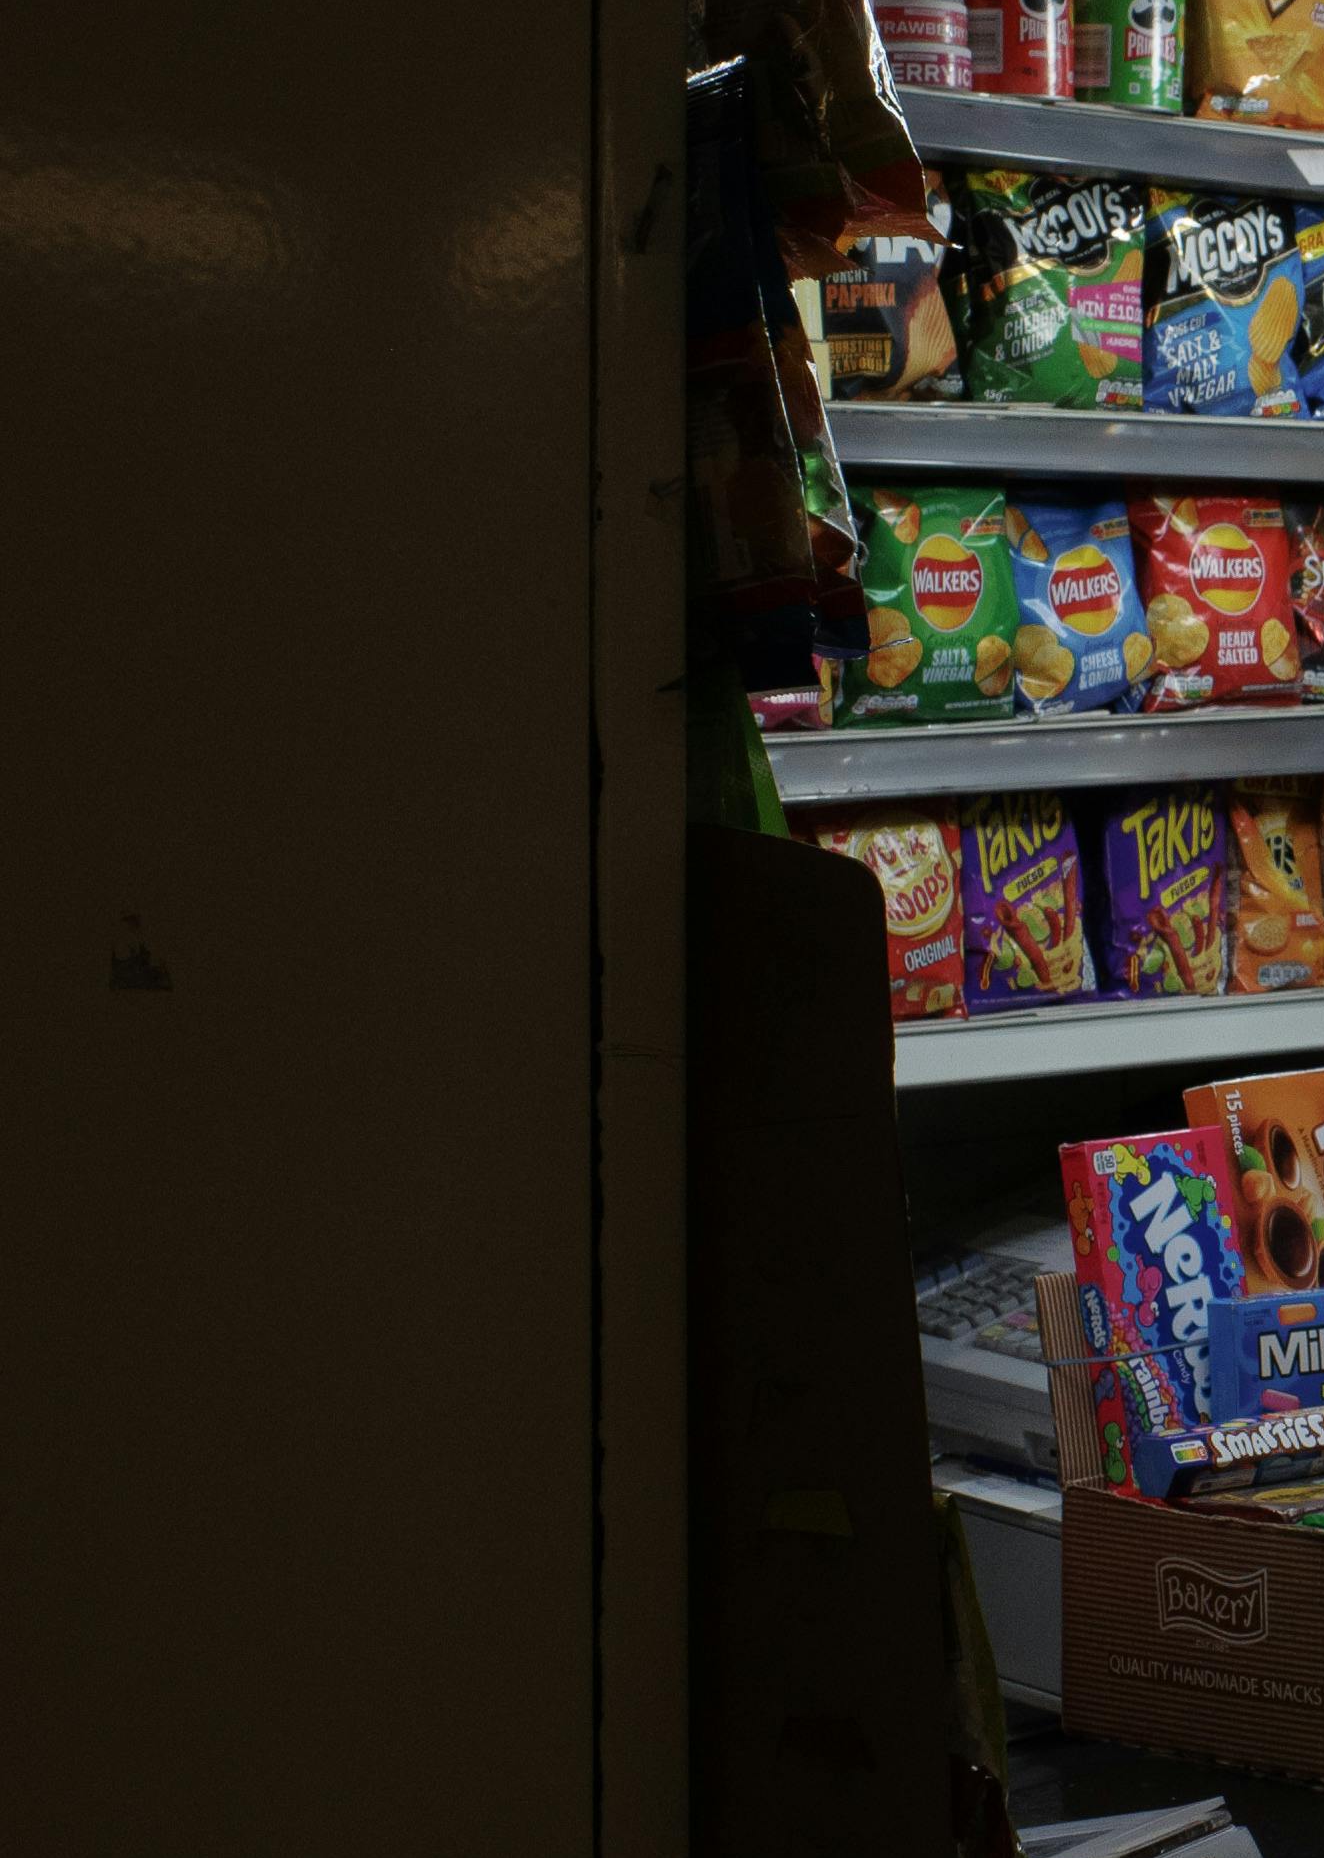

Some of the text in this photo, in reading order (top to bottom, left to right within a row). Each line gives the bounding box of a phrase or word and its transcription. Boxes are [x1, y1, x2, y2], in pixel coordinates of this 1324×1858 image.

[913, 567, 981, 595] WALKERS
[1191, 554, 1262, 582] WALKERS
[1049, 575, 1120, 605] WALKERS
[1219, 630, 1256, 650] READY
[1080, 649, 1122, 673] CHEESE
[1218, 648, 1258, 667] SALTED
[922, 664, 974, 684] VINEGAR
[966, 791, 1065, 890] Takis
[1122, 791, 1215, 899] Takis
[1014, 867, 1046, 893] FUEGO
[1169, 876, 1200, 900] FUEGO
[903, 937, 958, 975] ORIGINAL
[1224, 1088, 1246, 1156] 15 pieces
[1173, 1349, 1193, 1385] Candy
[1108, 1653, 1323, 1708] QUALITY HANDMADE SNACKS
